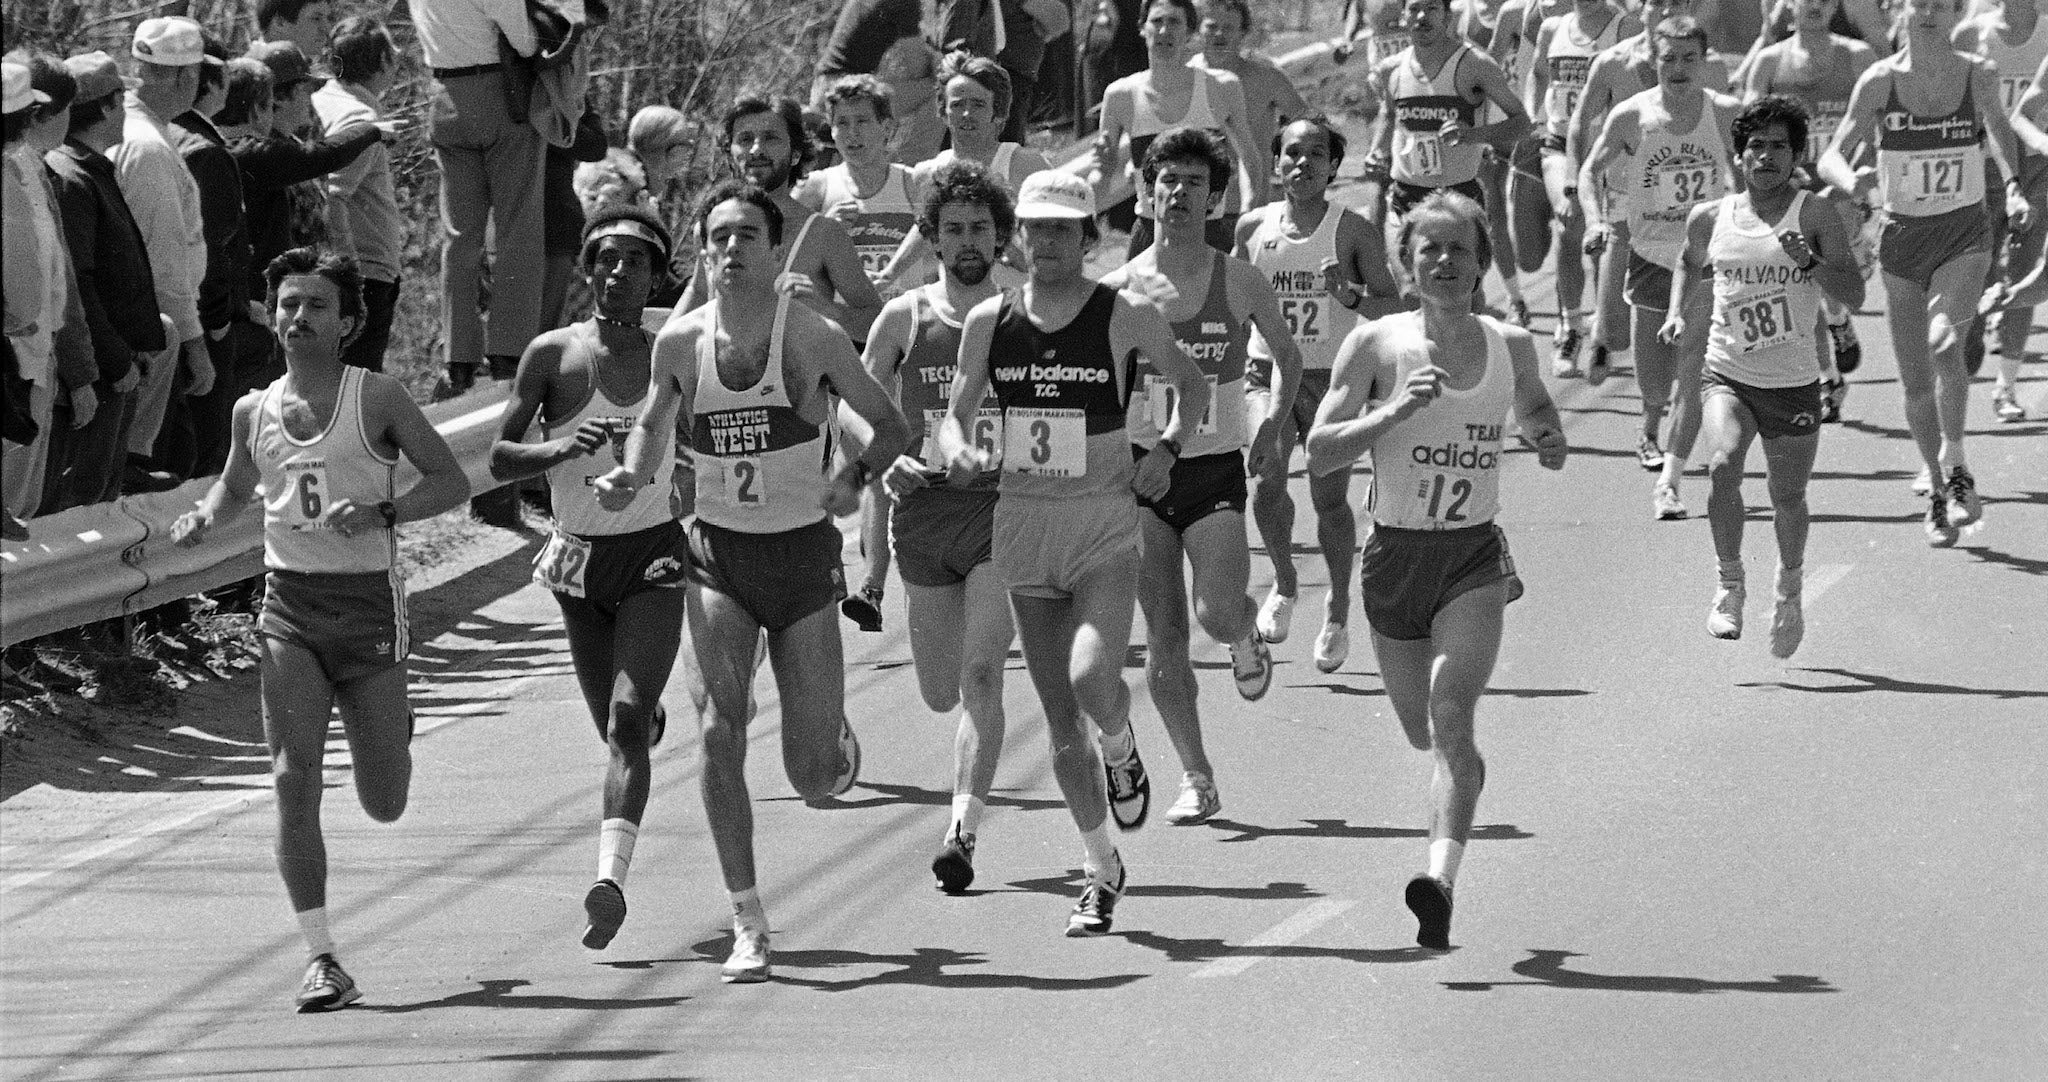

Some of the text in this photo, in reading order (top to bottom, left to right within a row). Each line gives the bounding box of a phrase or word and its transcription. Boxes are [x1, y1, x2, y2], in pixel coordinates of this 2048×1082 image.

[1643, 146, 1672, 188] WORLD
[1922, 159, 1964, 194] 127
[1674, 170, 1706, 203] 32
[1724, 265, 1813, 286] SALVADOR
[1283, 300, 1320, 336] 52
[1740, 295, 1792, 343] 387
[995, 363, 1109, 383] new balance
[1034, 383, 1060, 398] T.C.
[708, 409, 769, 428] ATHLETICS
[1044, 410, 1085, 418] MARATHON
[710, 423, 771, 454] WEST
[1030, 420, 1052, 465] 3
[299, 472, 322, 519] 6
[734, 460, 759, 503] 2
[1427, 473, 1473, 522] 12
